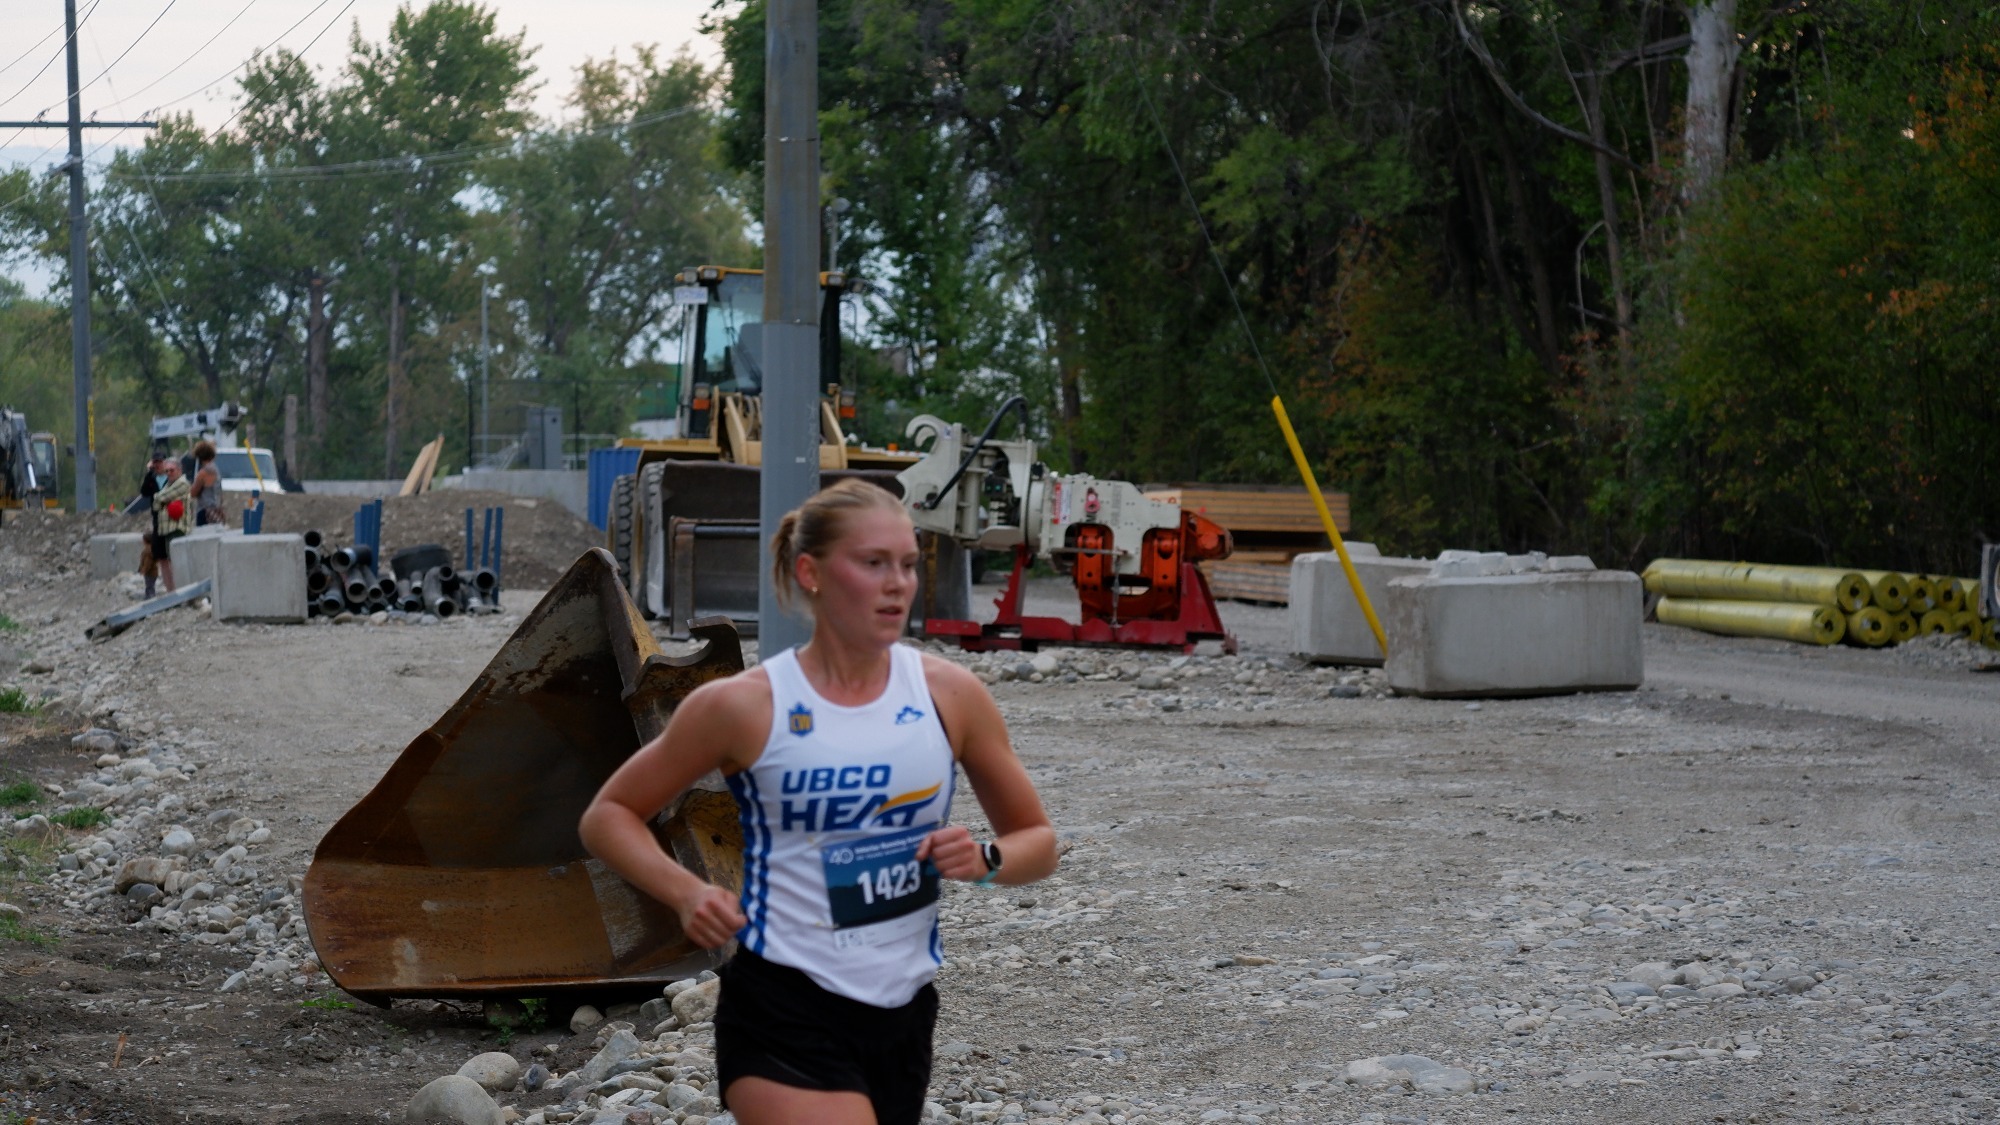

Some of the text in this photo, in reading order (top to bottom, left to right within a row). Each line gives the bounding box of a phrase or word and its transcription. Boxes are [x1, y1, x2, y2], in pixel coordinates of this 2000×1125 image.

[781, 765, 891, 794] UBCO
[781, 788, 940, 831] HEAT
[857, 859, 922, 905] 1423
